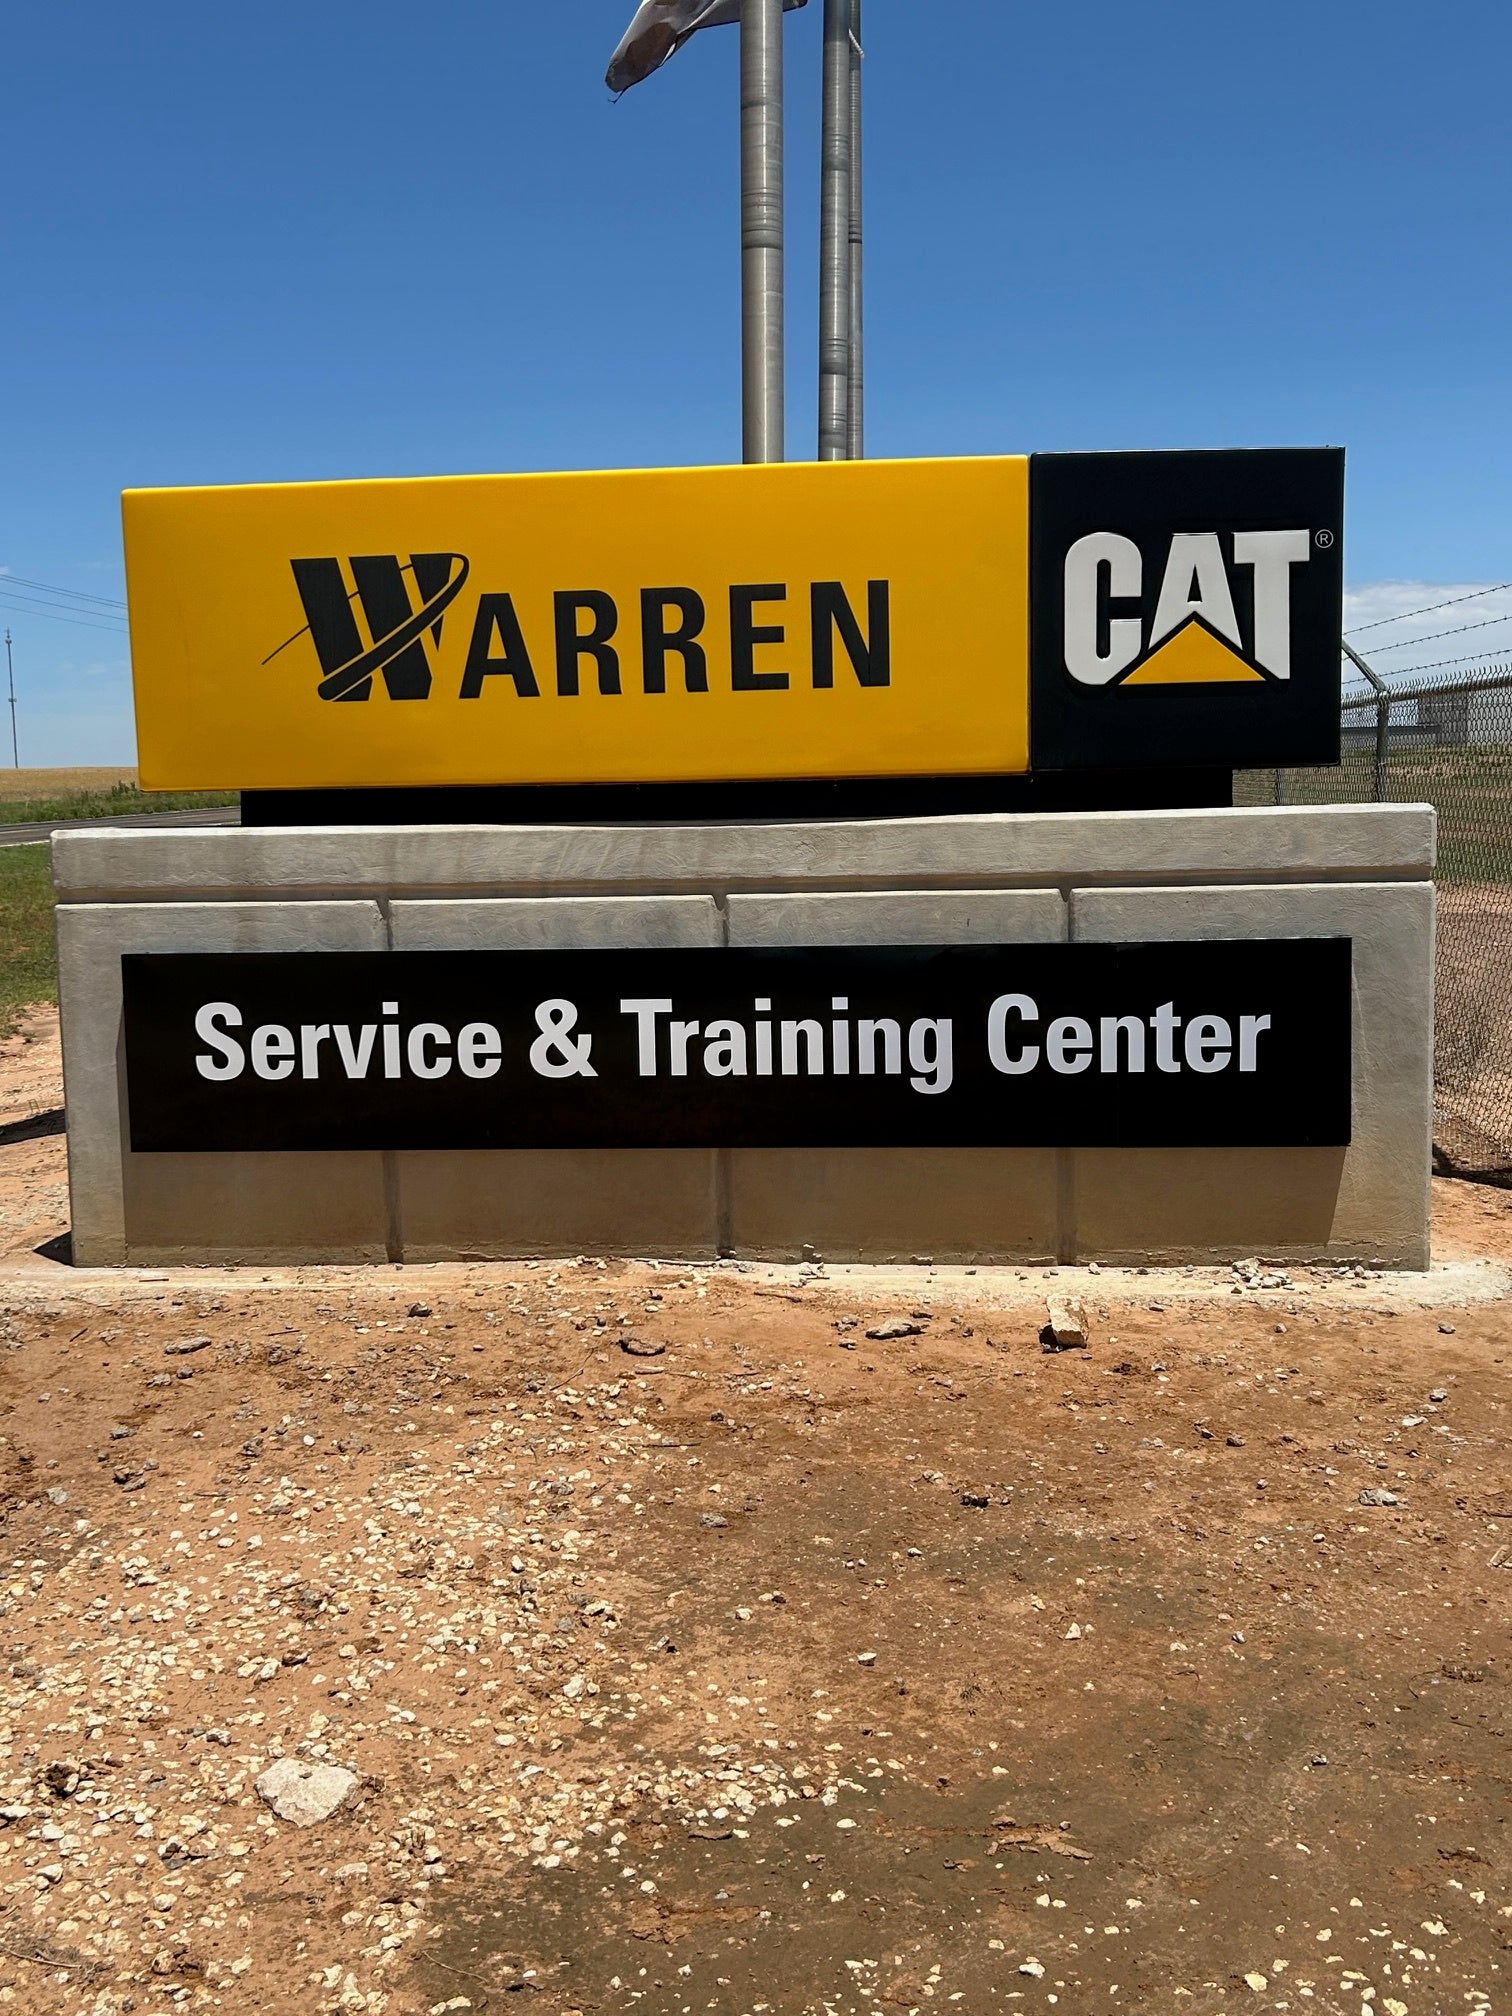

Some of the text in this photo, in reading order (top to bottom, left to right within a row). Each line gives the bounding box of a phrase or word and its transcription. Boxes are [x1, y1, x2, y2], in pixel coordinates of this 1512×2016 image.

[288, 552, 892, 703] WARREN
[1062, 528, 1311, 686] CAT
[193, 992, 1272, 1096] Service & Training Center
